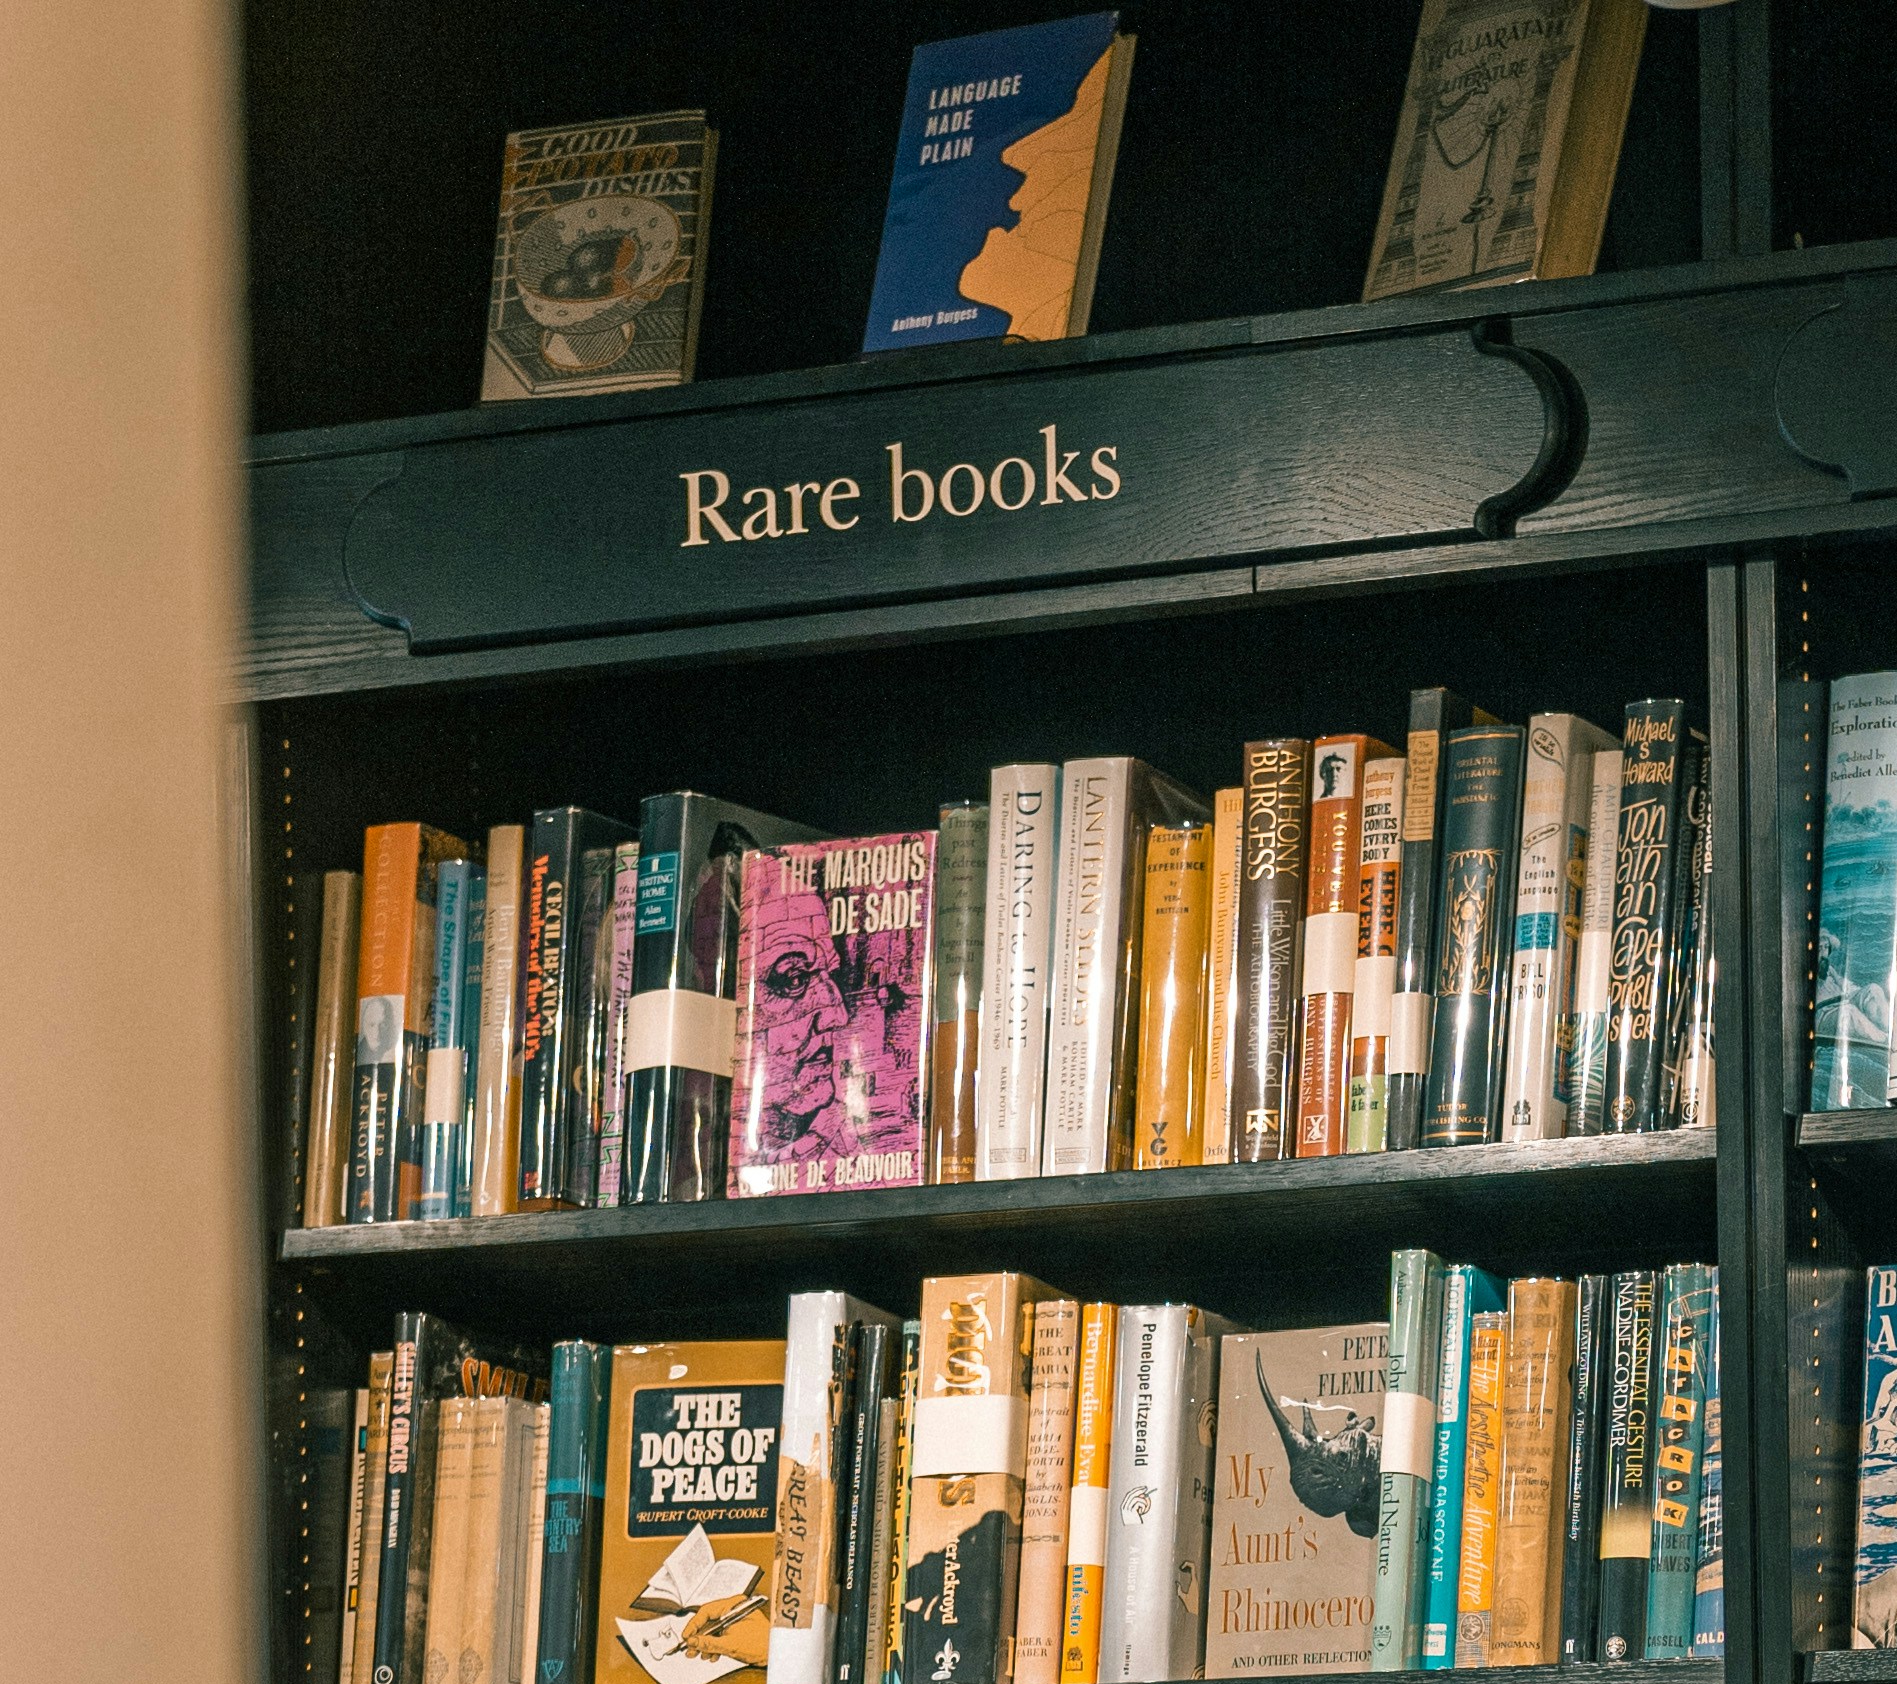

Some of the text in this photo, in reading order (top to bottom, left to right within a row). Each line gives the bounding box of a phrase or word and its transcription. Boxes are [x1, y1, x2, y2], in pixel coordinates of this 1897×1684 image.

[928, 74, 1022, 110] LANGUAGE
[925, 110, 974, 138] MADE
[920, 136, 974, 167] PLAIN
[891, 307, 978, 335] Anthony Burgess
[680, 425, 1121, 548] Rare books
[1247, 749, 1277, 881] BURGESS
[780, 843, 926, 894] THE MARQUIS
[831, 890, 923, 936] DE SADE
[674, 1393, 741, 1431] THE
[1134, 1322, 1157, 1468] Penelope Fitzgerald
[640, 1429, 776, 1467] DOGS OF
[650, 1467, 757, 1503] PEACE
[1226, 1451, 1274, 1508] My
[637, 1505, 769, 1523] RUPERT CROFT-COOKE
[1222, 1516, 1319, 1565] Aunt's
